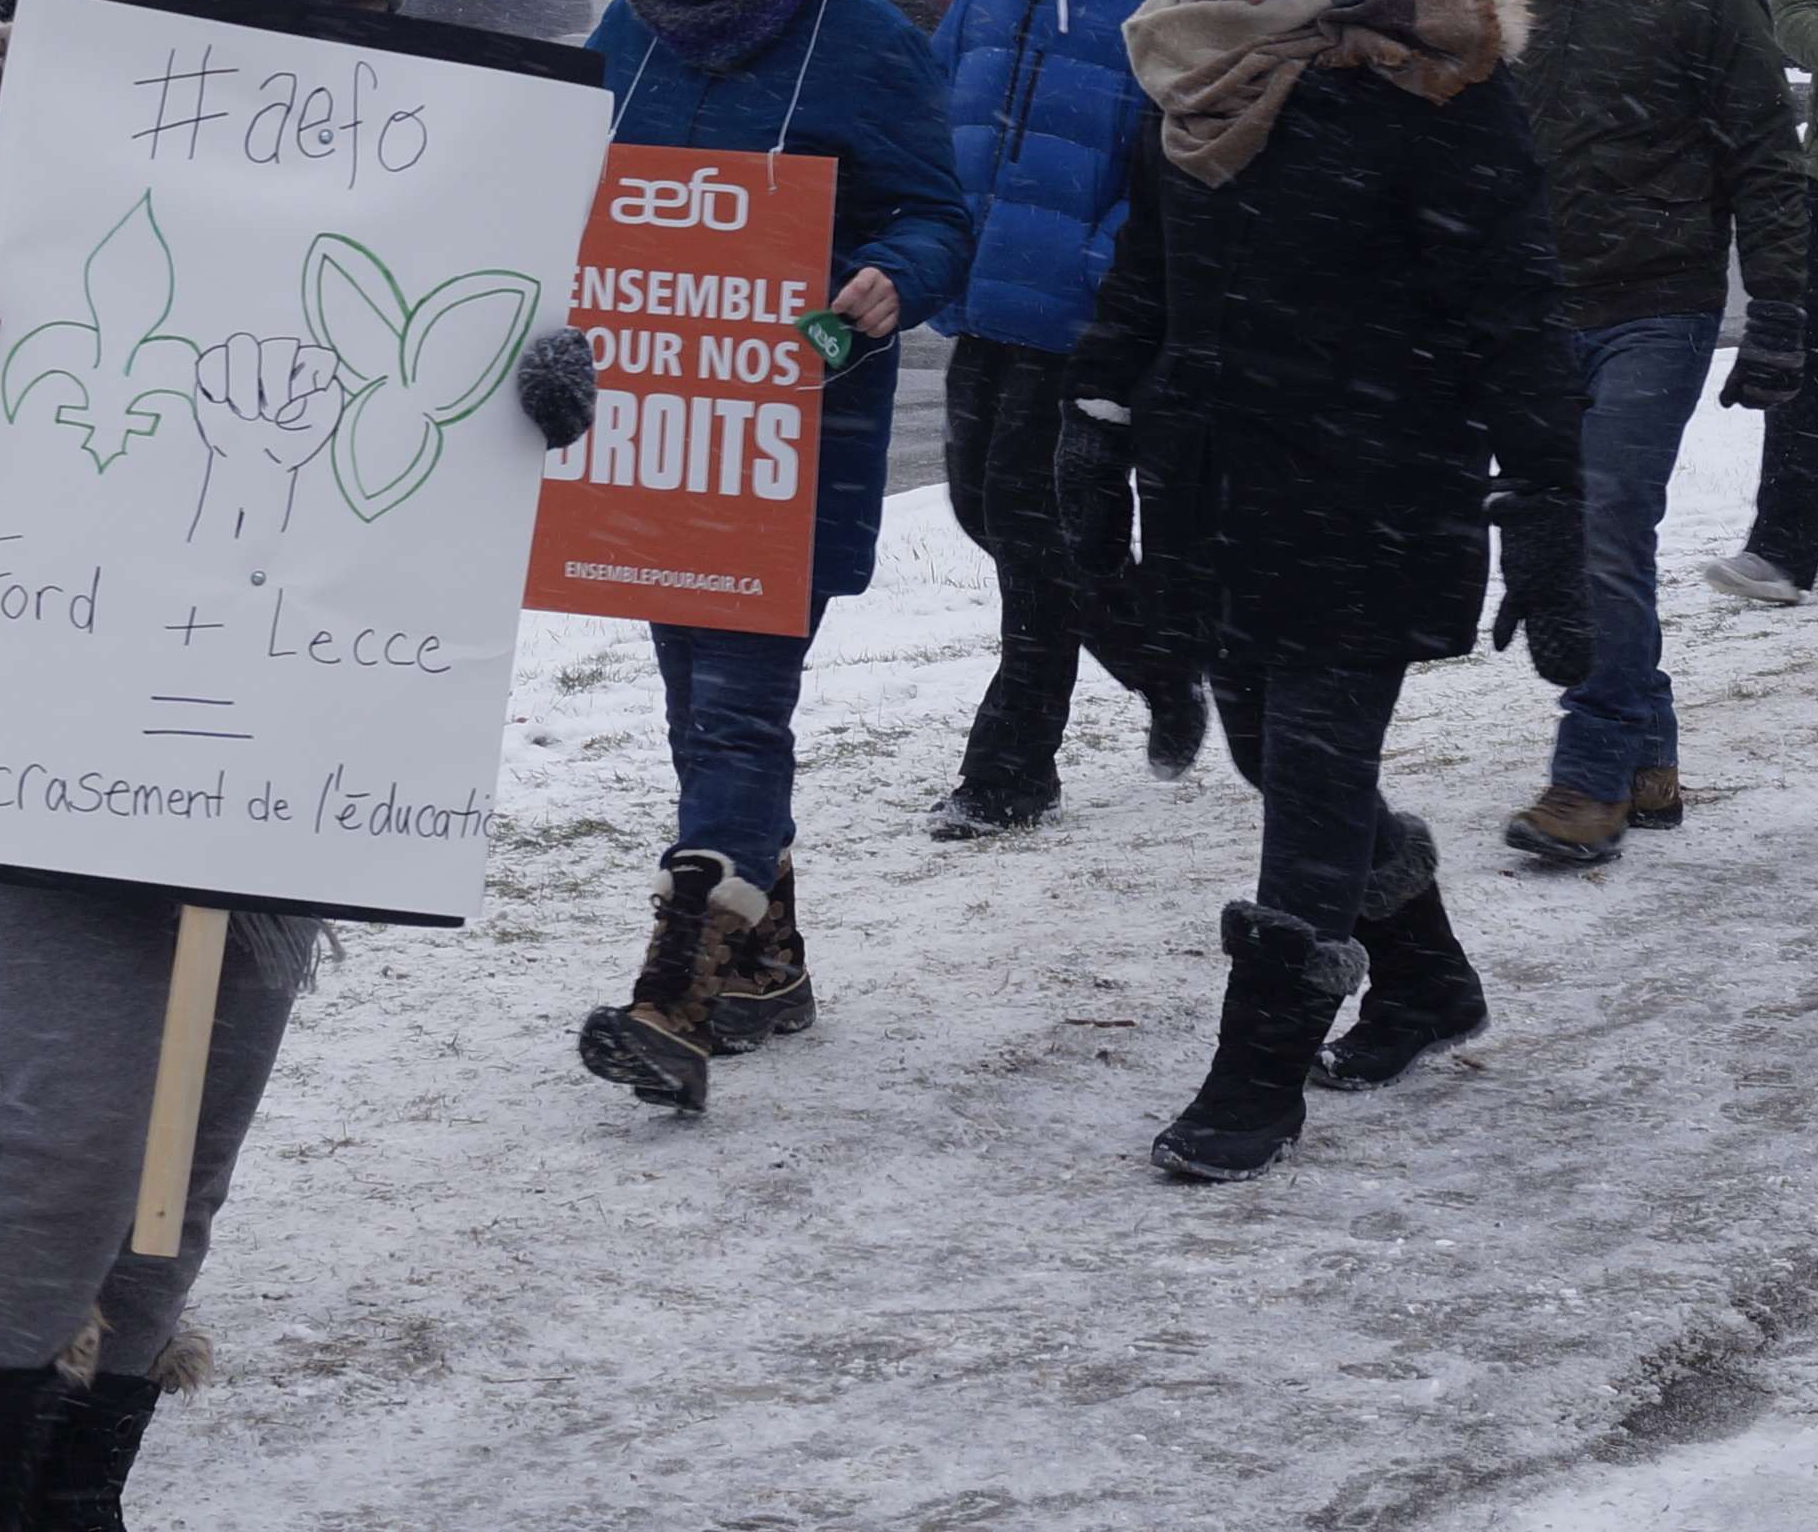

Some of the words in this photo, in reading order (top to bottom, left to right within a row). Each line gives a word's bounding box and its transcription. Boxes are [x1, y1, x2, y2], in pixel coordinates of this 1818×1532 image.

[132, 45, 427, 189] #aefo
[585, 326, 683, 378] OUR
[697, 334, 800, 386] NOS
[565, 561, 764, 596] ENSEMBLEPOURAGIR.CA
[270, 589, 452, 674] Lecce
[247, 780, 293, 822] de
